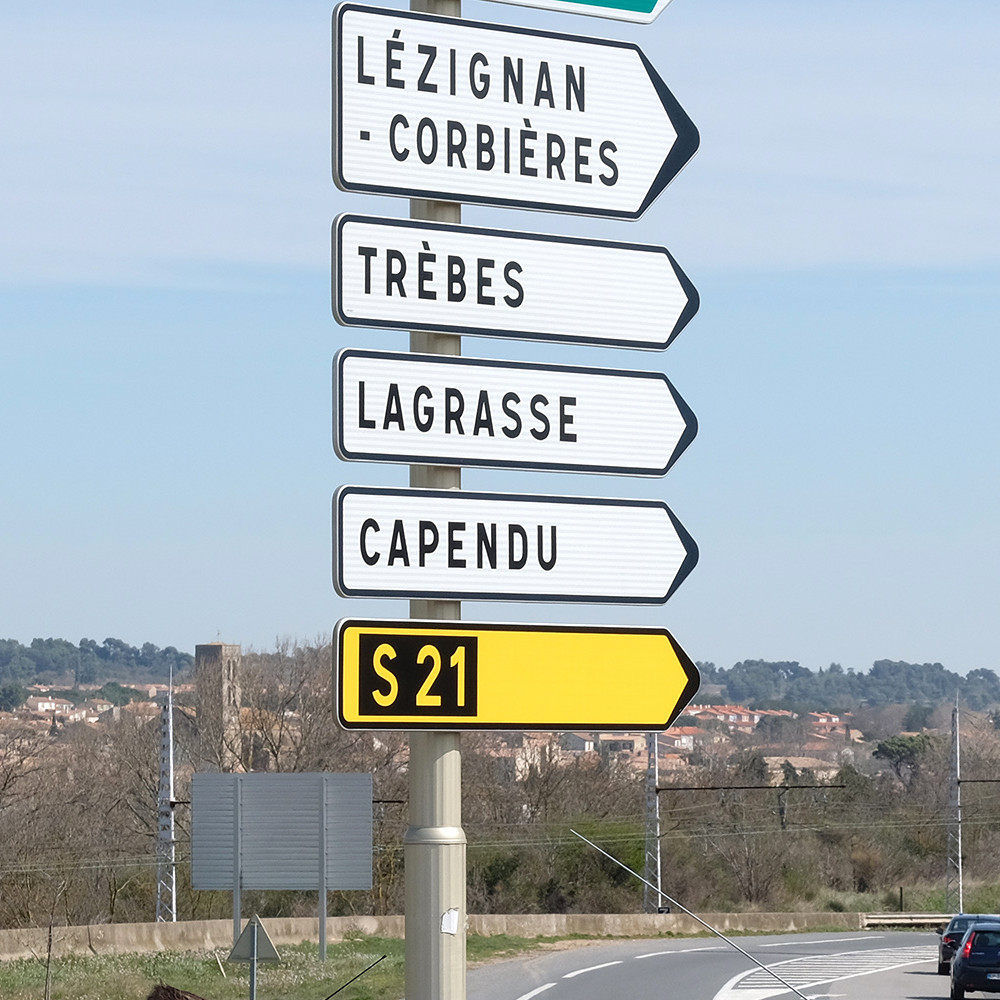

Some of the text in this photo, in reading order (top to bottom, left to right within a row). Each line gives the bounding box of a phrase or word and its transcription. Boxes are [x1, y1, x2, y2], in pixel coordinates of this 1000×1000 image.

[358, 29, 586, 112] LÉZIGNAN
[389, 113, 619, 187] CORBIÈRES
[358, 241, 525, 308] TRÈBES
[358, 381, 578, 443] LAGRASSE
[360, 518, 558, 572] CAPENDU
[371, 643, 466, 707] S 21
